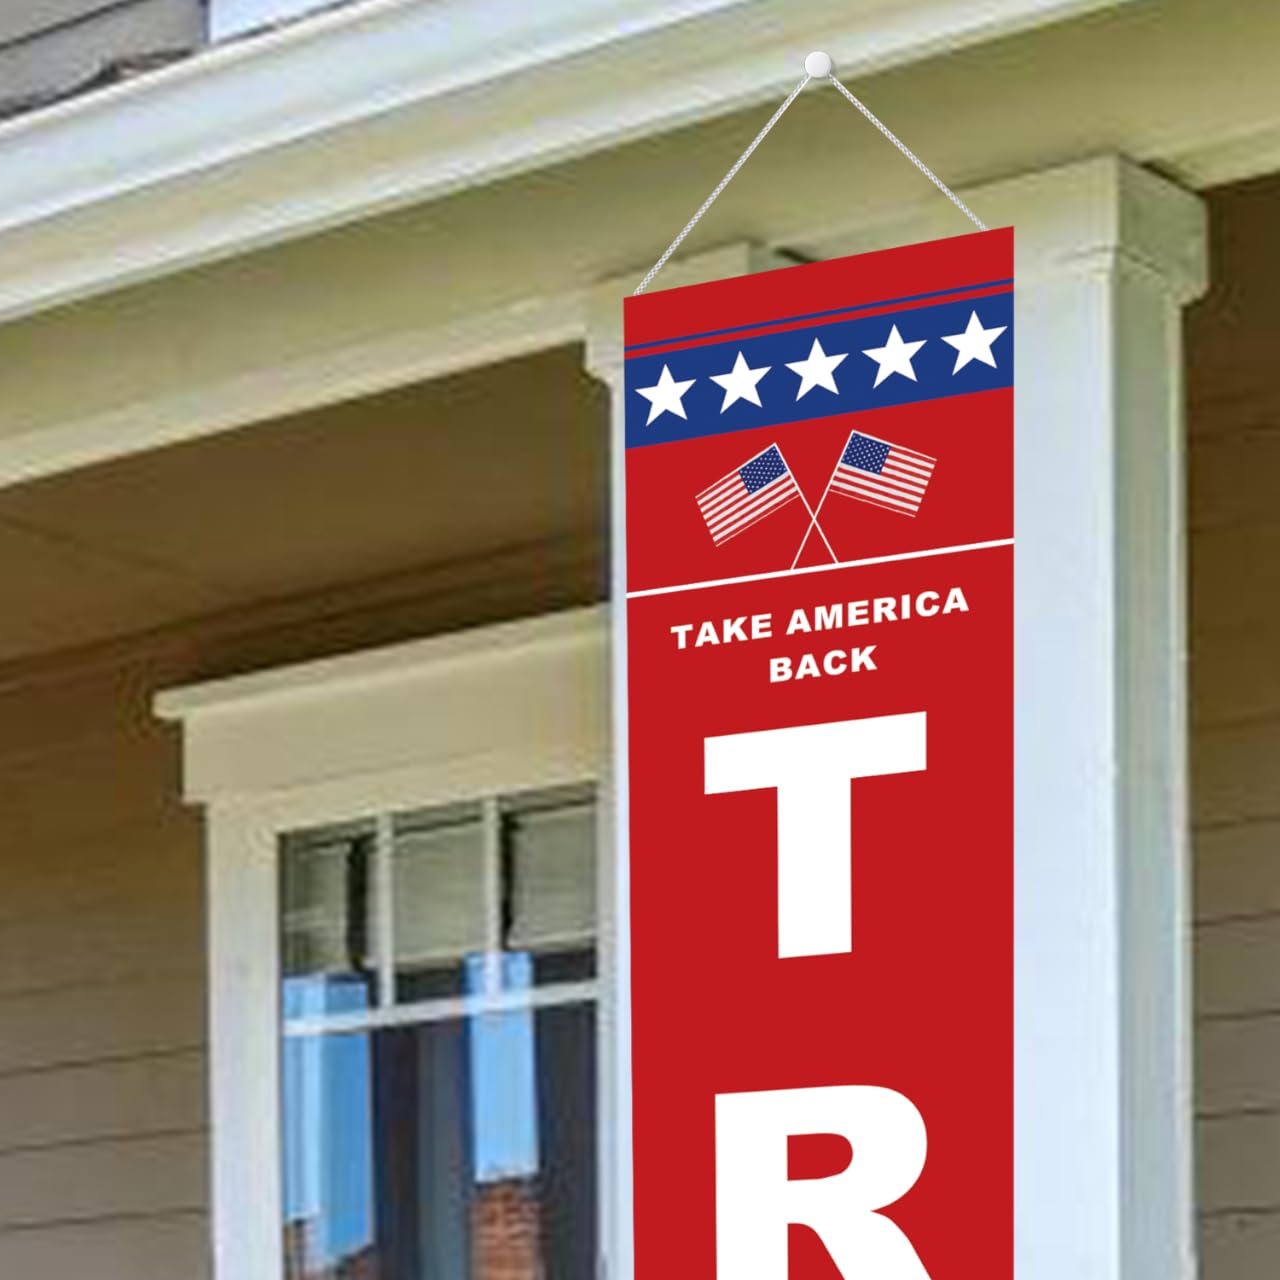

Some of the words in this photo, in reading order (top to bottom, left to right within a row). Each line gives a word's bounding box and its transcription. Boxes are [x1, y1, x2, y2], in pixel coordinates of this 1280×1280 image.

[670, 613, 772, 649] TAKE
[786, 587, 969, 635] AMERICA
[769, 645, 877, 683] BACK
